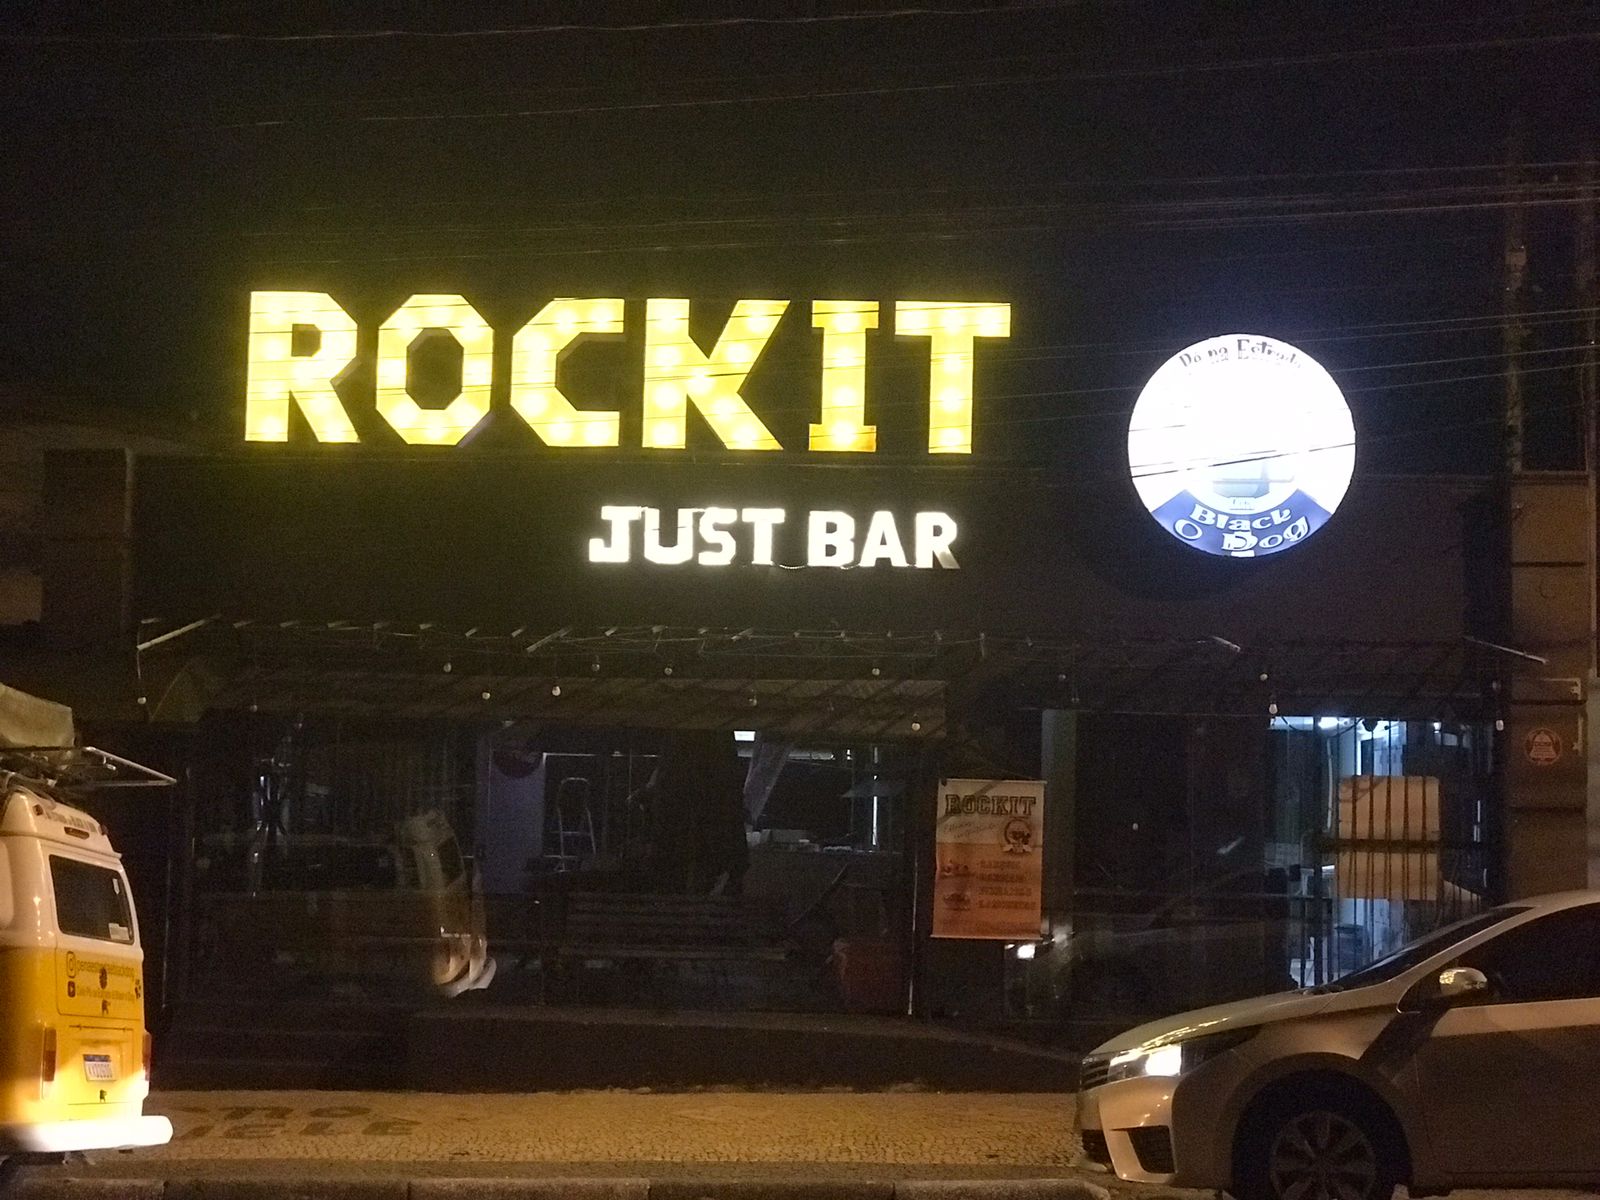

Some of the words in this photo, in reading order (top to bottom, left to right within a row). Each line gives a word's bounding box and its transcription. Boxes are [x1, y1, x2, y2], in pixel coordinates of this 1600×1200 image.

[244, 290, 1012, 454] ROCKIT
[1189, 503, 1292, 532] Black
[1221, 516, 1311, 552] Dog
[589, 506, 786, 566] JUST
[807, 510, 961, 570] BAR
[945, 794, 1037, 817] ROCKIT
